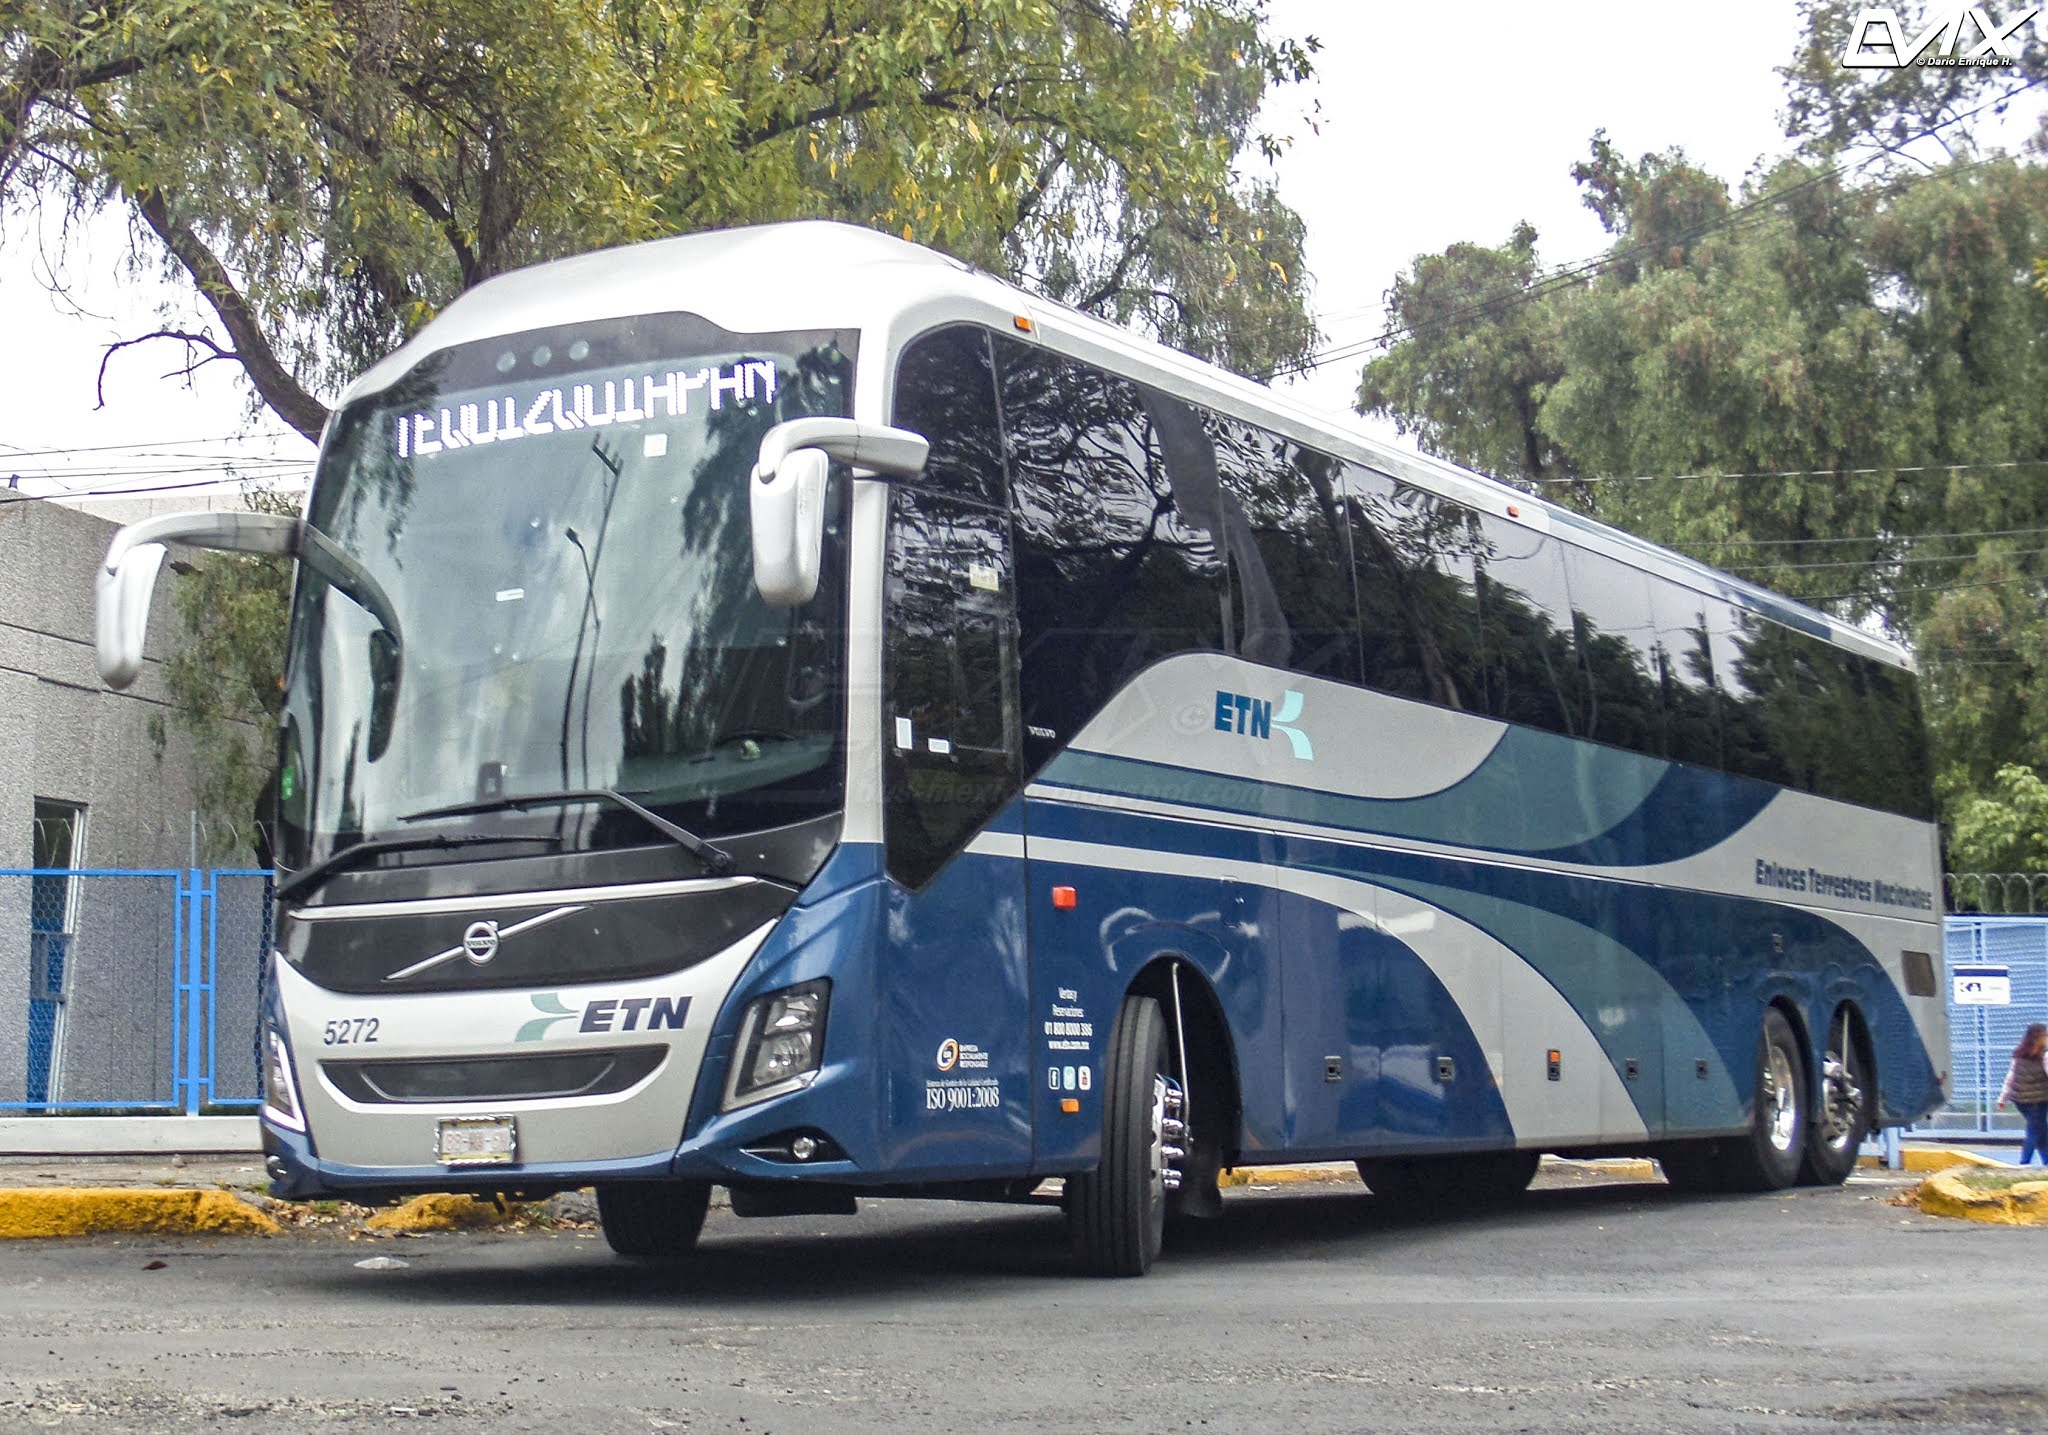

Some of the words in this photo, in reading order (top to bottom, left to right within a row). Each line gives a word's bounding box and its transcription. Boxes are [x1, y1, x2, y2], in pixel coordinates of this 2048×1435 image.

[1214, 690, 1272, 739] ETN
[579, 996, 693, 1032] ETN
[323, 1017, 380, 1045] 5272
[926, 1087, 946, 1110] ISO
[947, 1086, 1000, 1112] 9001:2008
